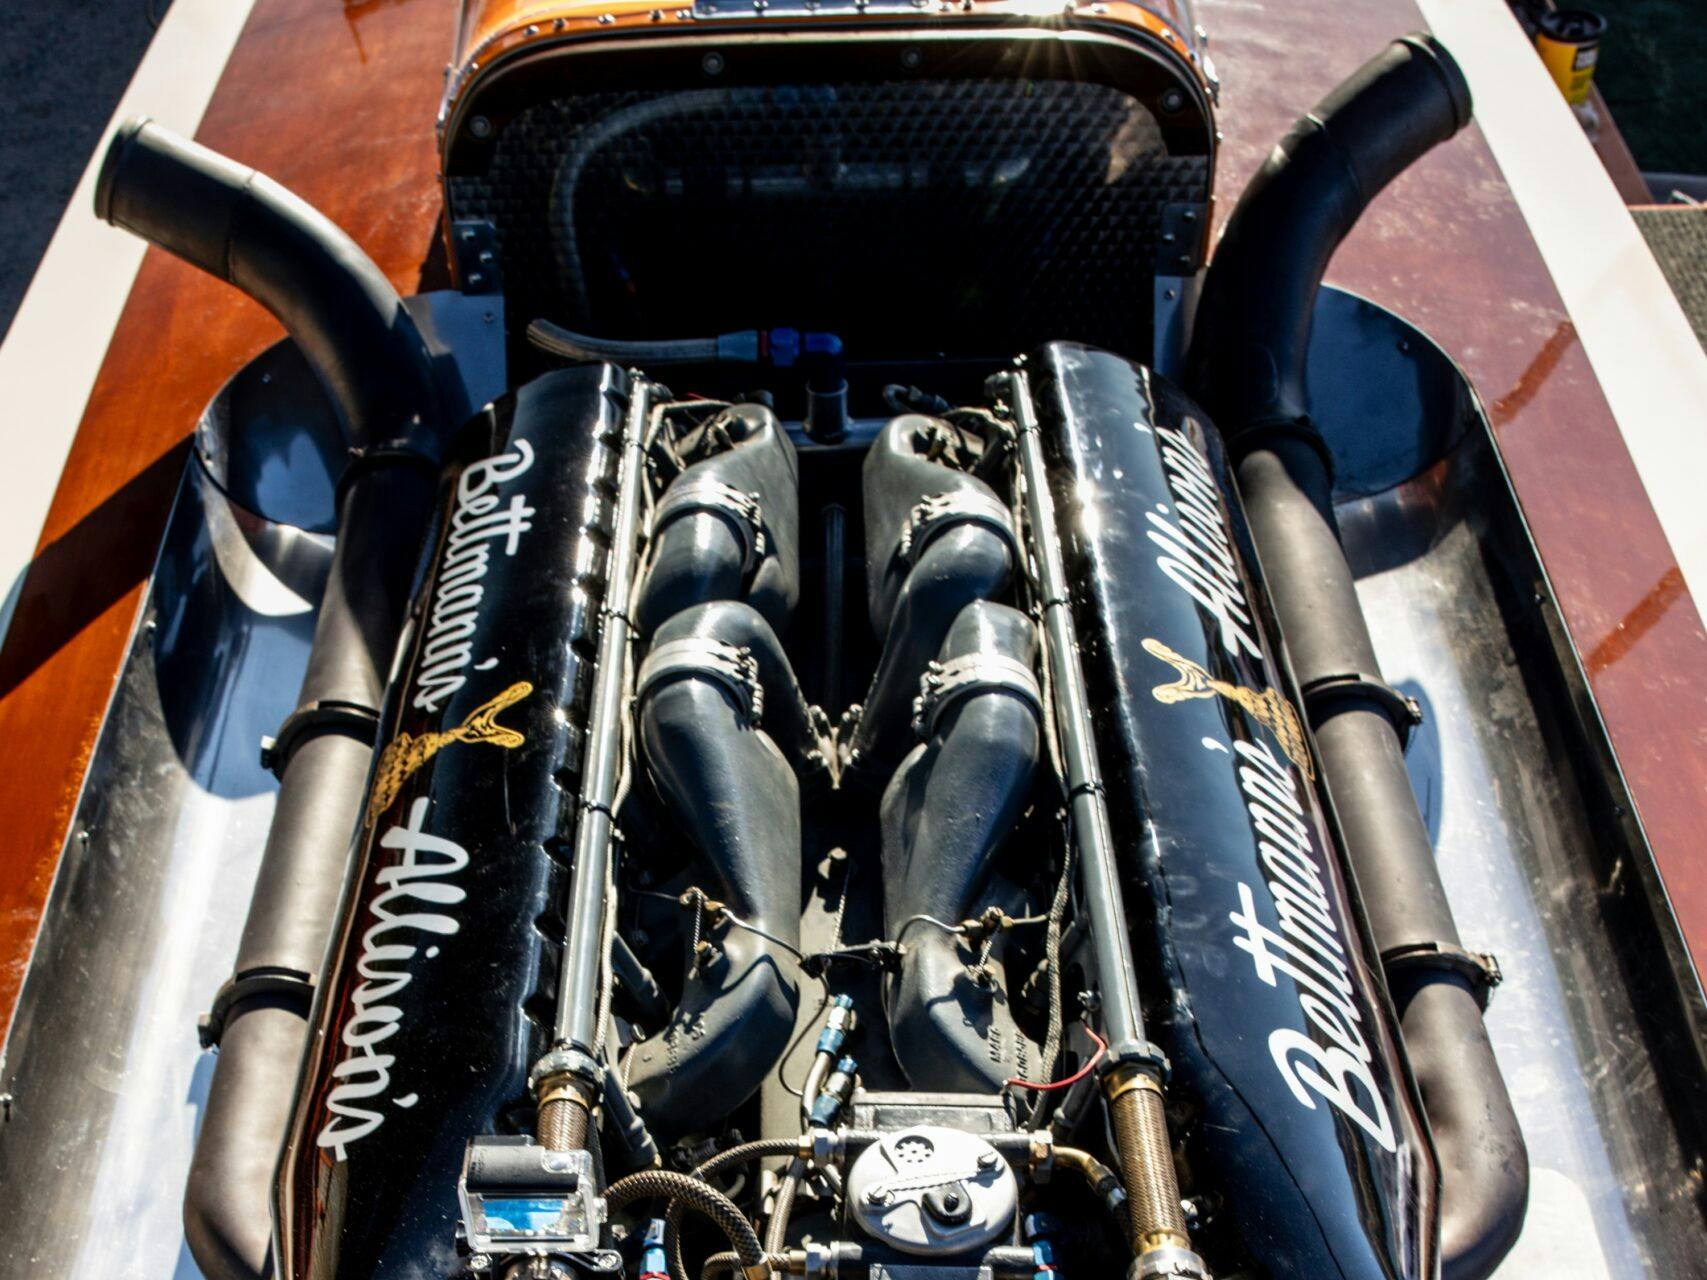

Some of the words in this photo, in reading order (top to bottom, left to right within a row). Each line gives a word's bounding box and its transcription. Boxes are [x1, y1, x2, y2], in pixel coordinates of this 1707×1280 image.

[413, 439, 535, 711] Bettmann's
[1133, 422, 1263, 658] Allison's
[317, 797, 468, 1161] Allison's
[1202, 737, 1396, 1153] Bettmann's
